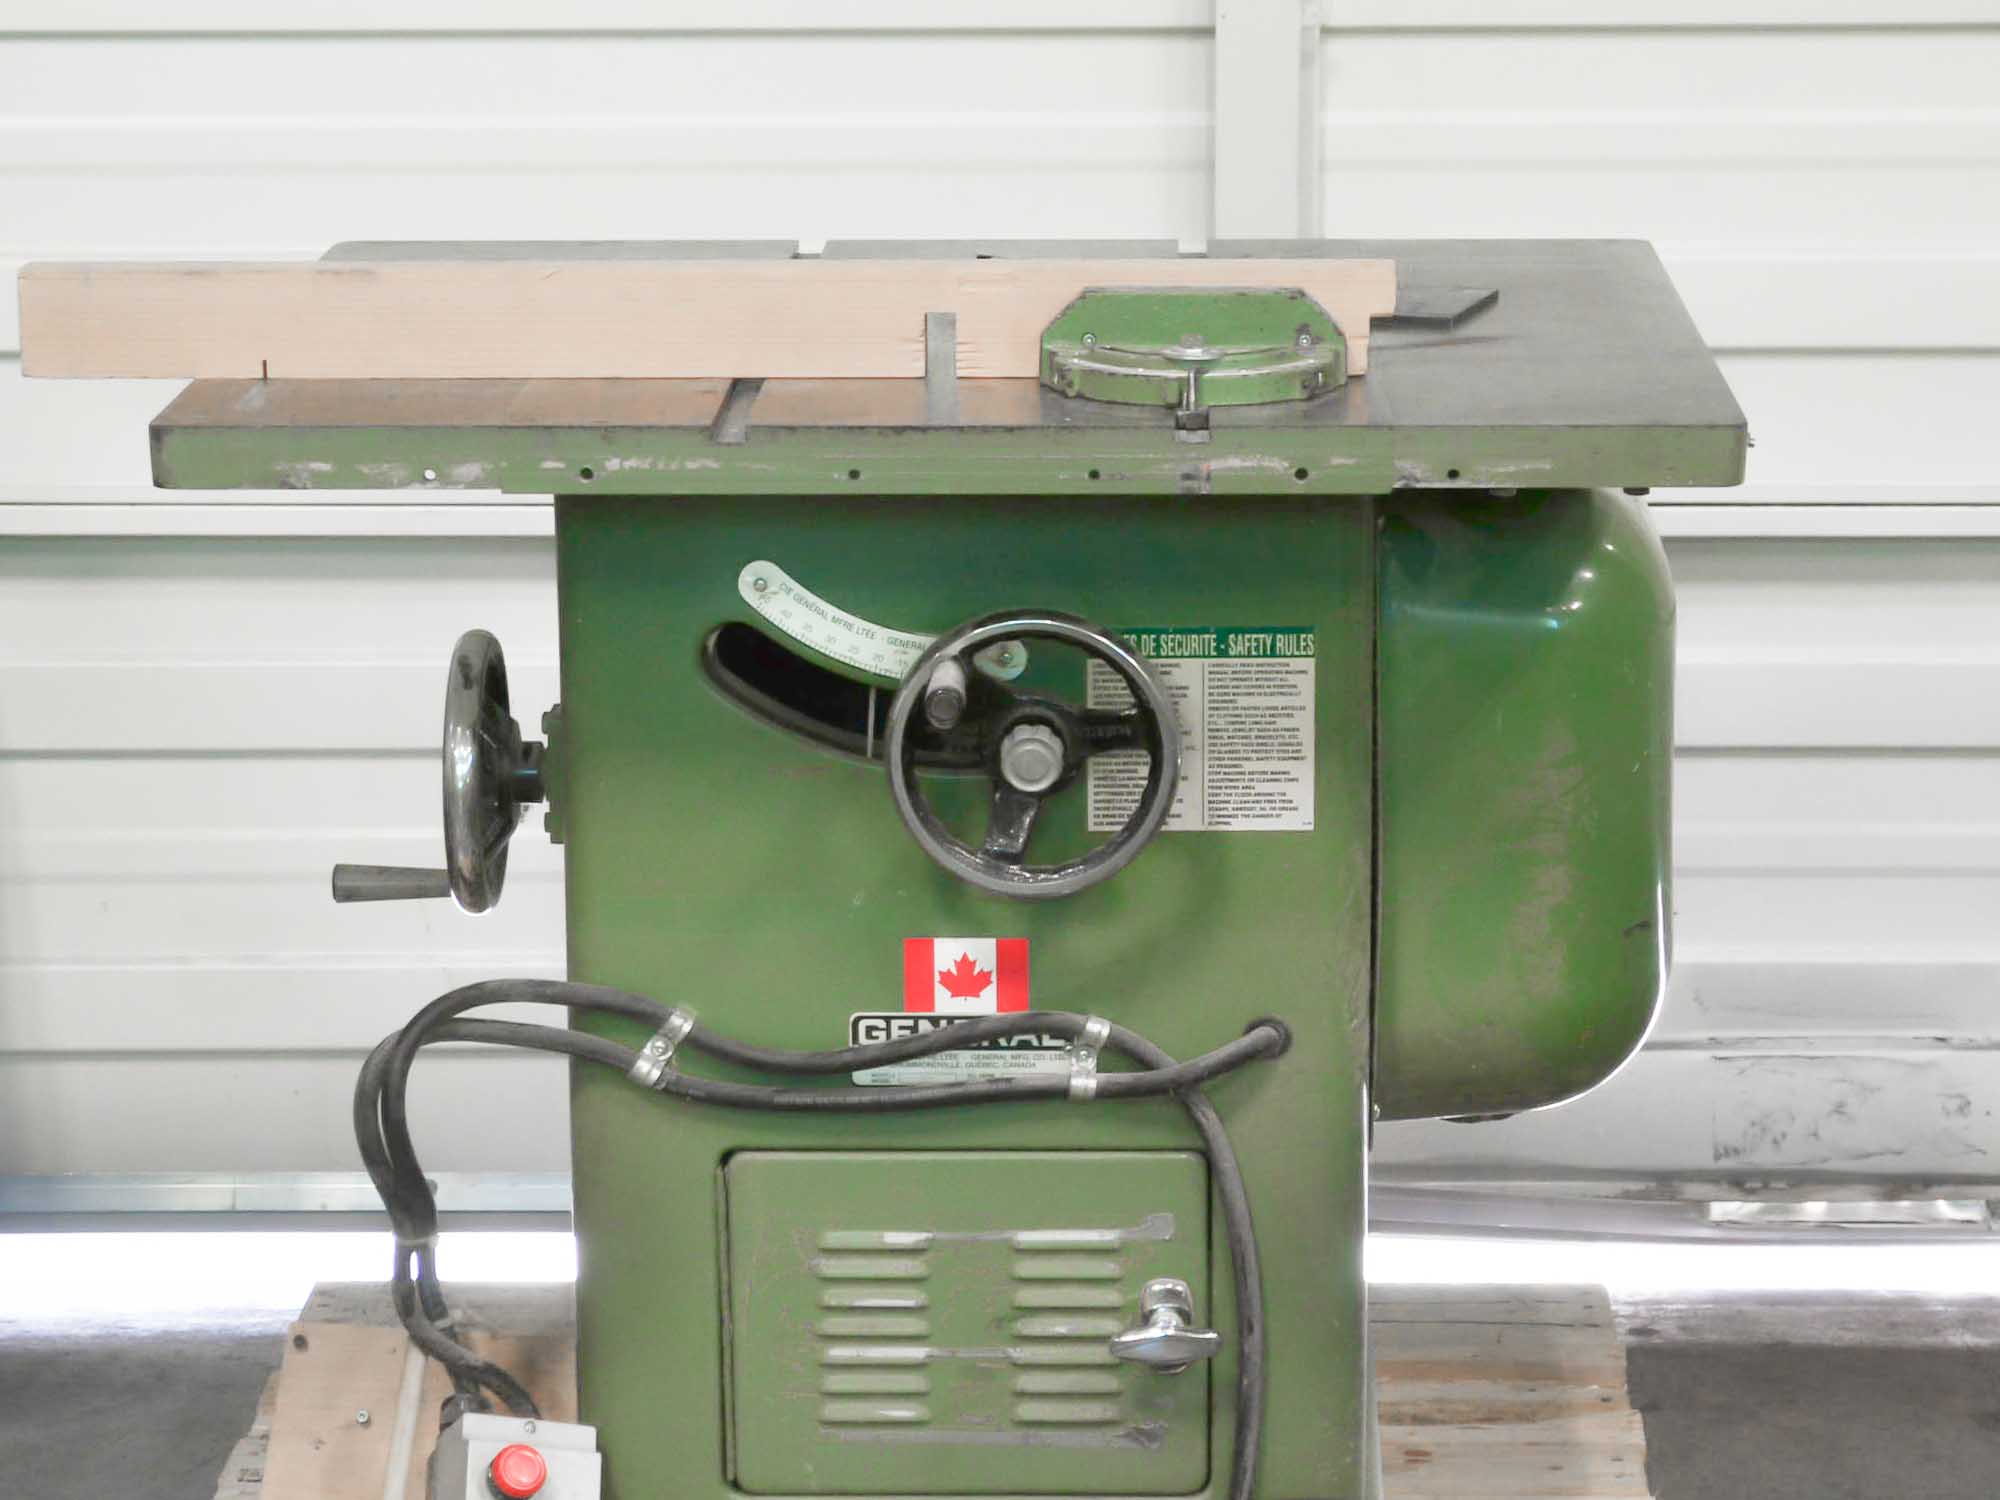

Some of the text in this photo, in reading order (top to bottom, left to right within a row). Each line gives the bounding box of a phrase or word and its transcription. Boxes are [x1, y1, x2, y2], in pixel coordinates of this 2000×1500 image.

[1141, 633, 1157, 656] DE
[1228, 633, 1273, 656] SAFETY
[1276, 633, 1315, 656] RULES
